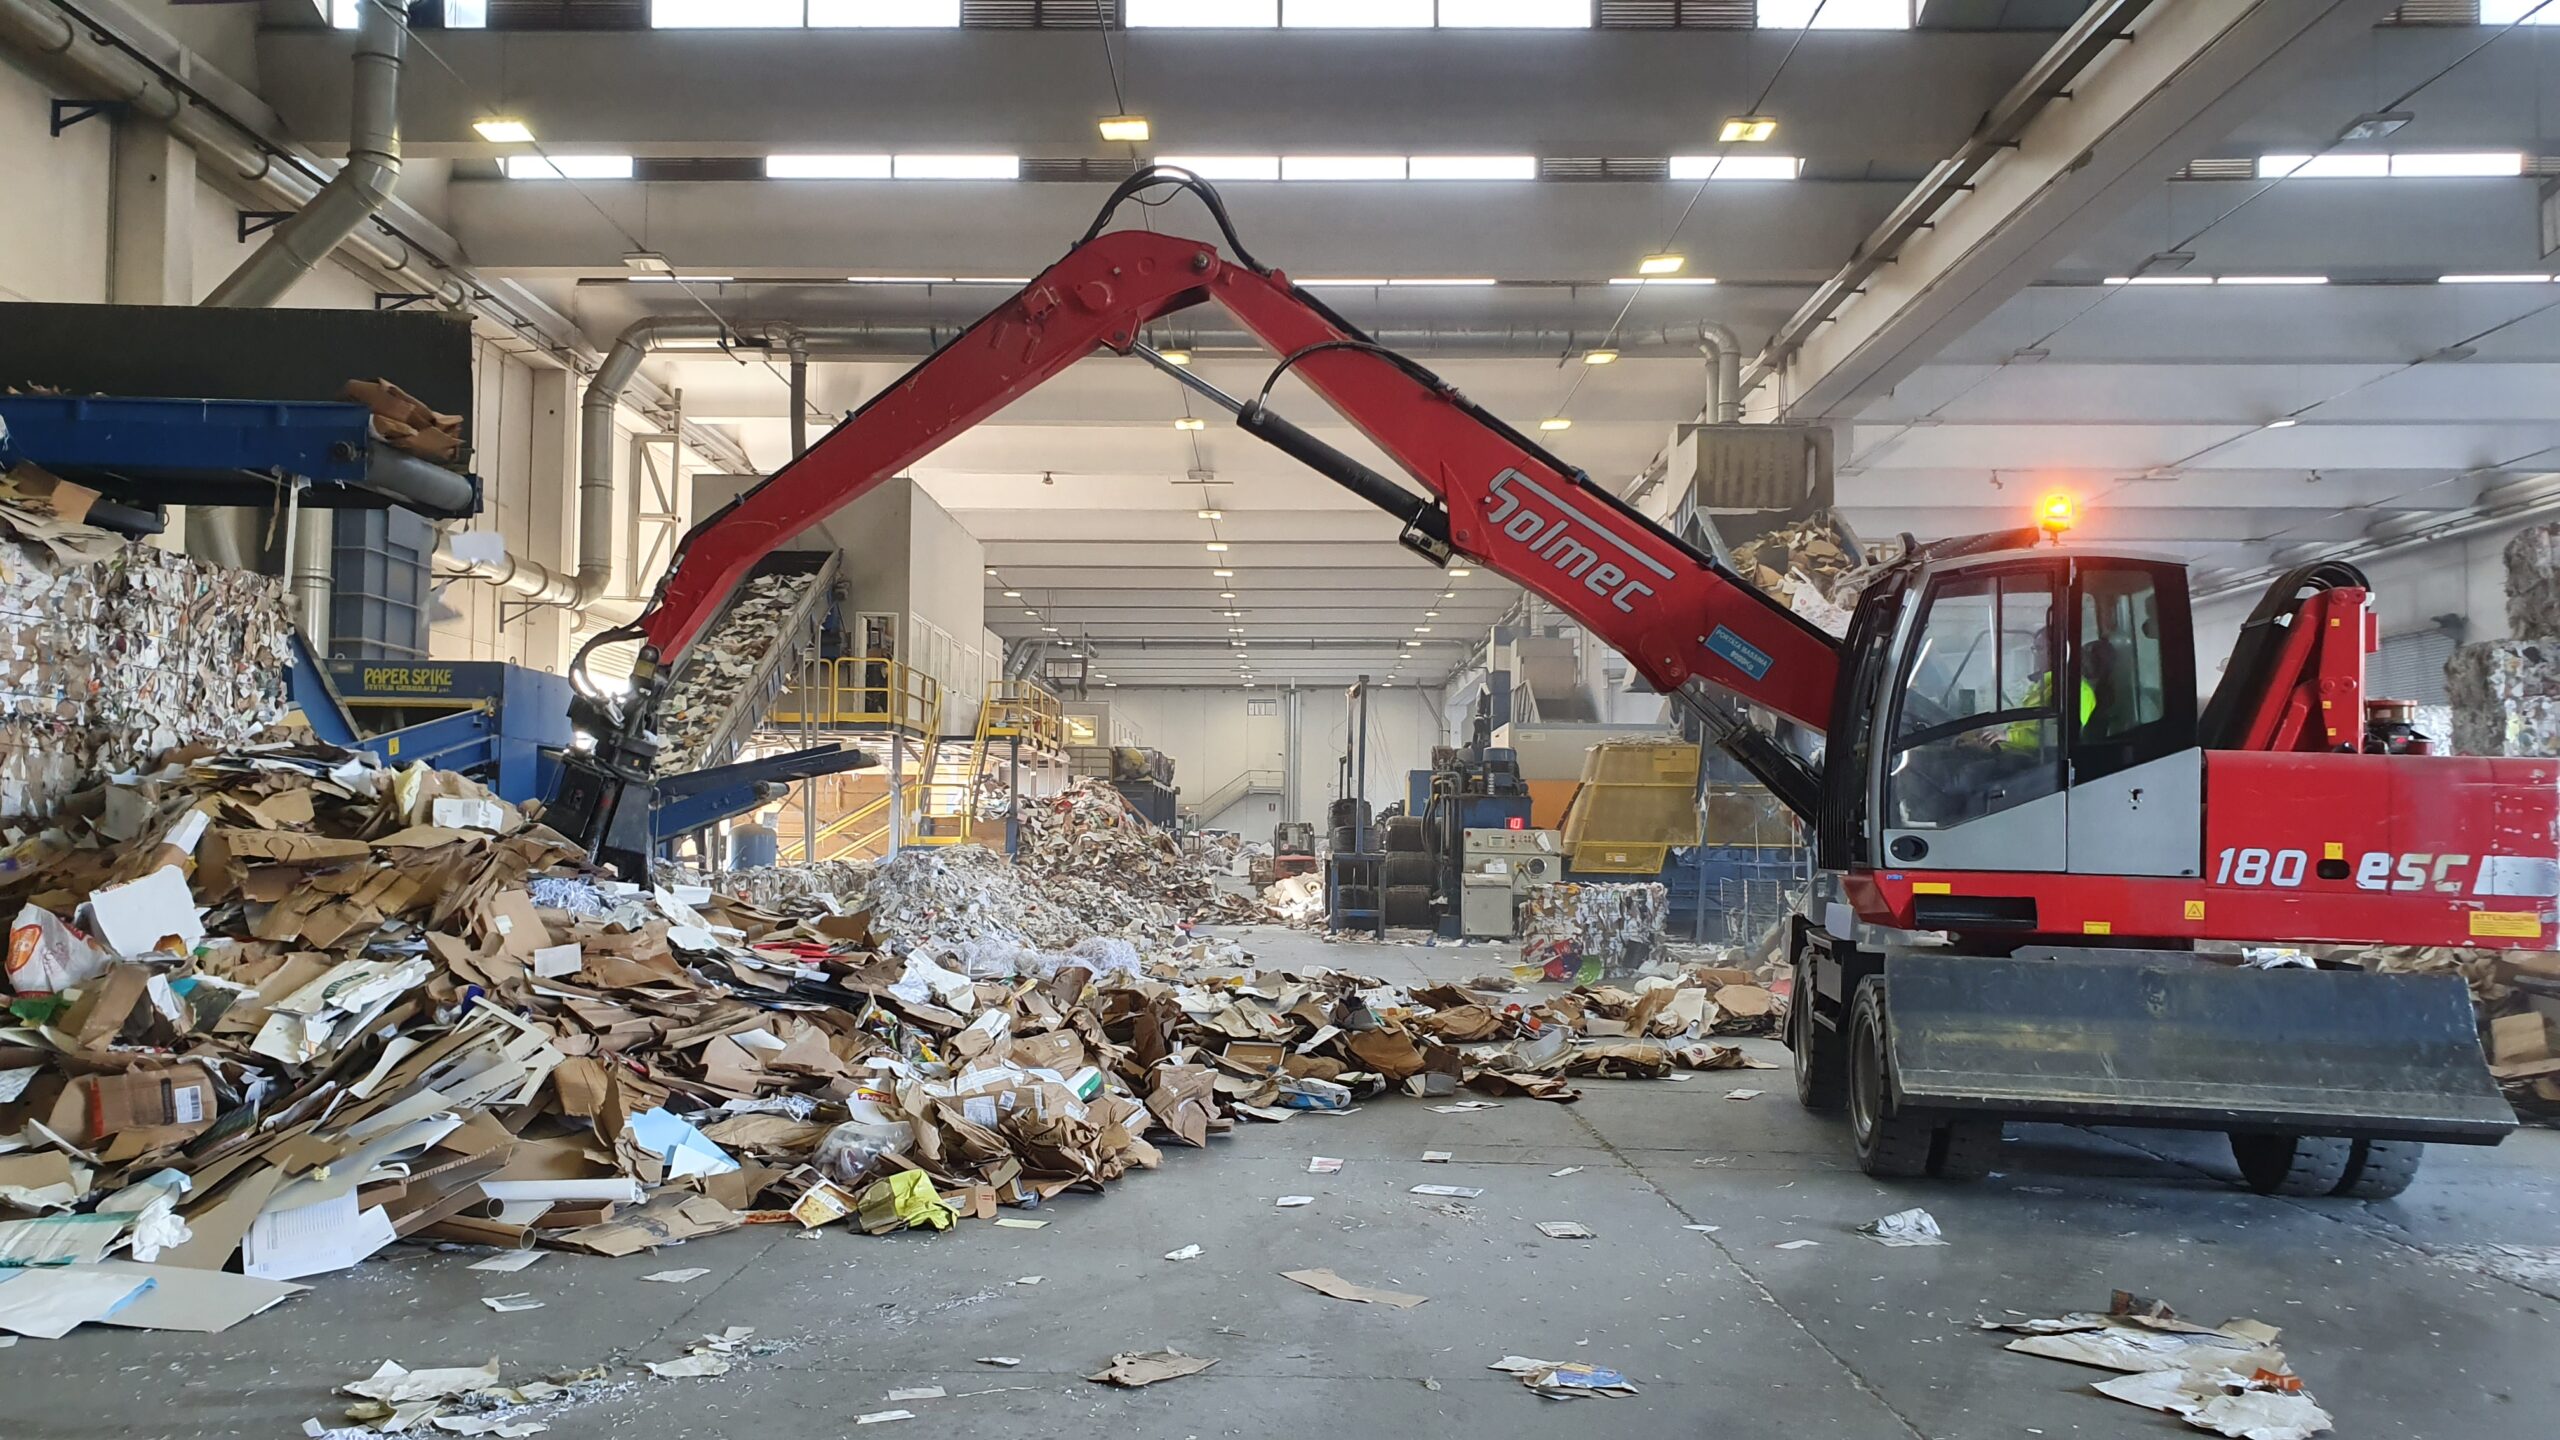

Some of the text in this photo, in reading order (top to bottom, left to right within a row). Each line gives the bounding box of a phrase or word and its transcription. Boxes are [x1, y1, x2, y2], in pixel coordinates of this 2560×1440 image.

[1487, 467, 1676, 613] Solmec
[364, 667, 453, 686] PAPER SPIKE
[2215, 847, 2308, 887] 180
